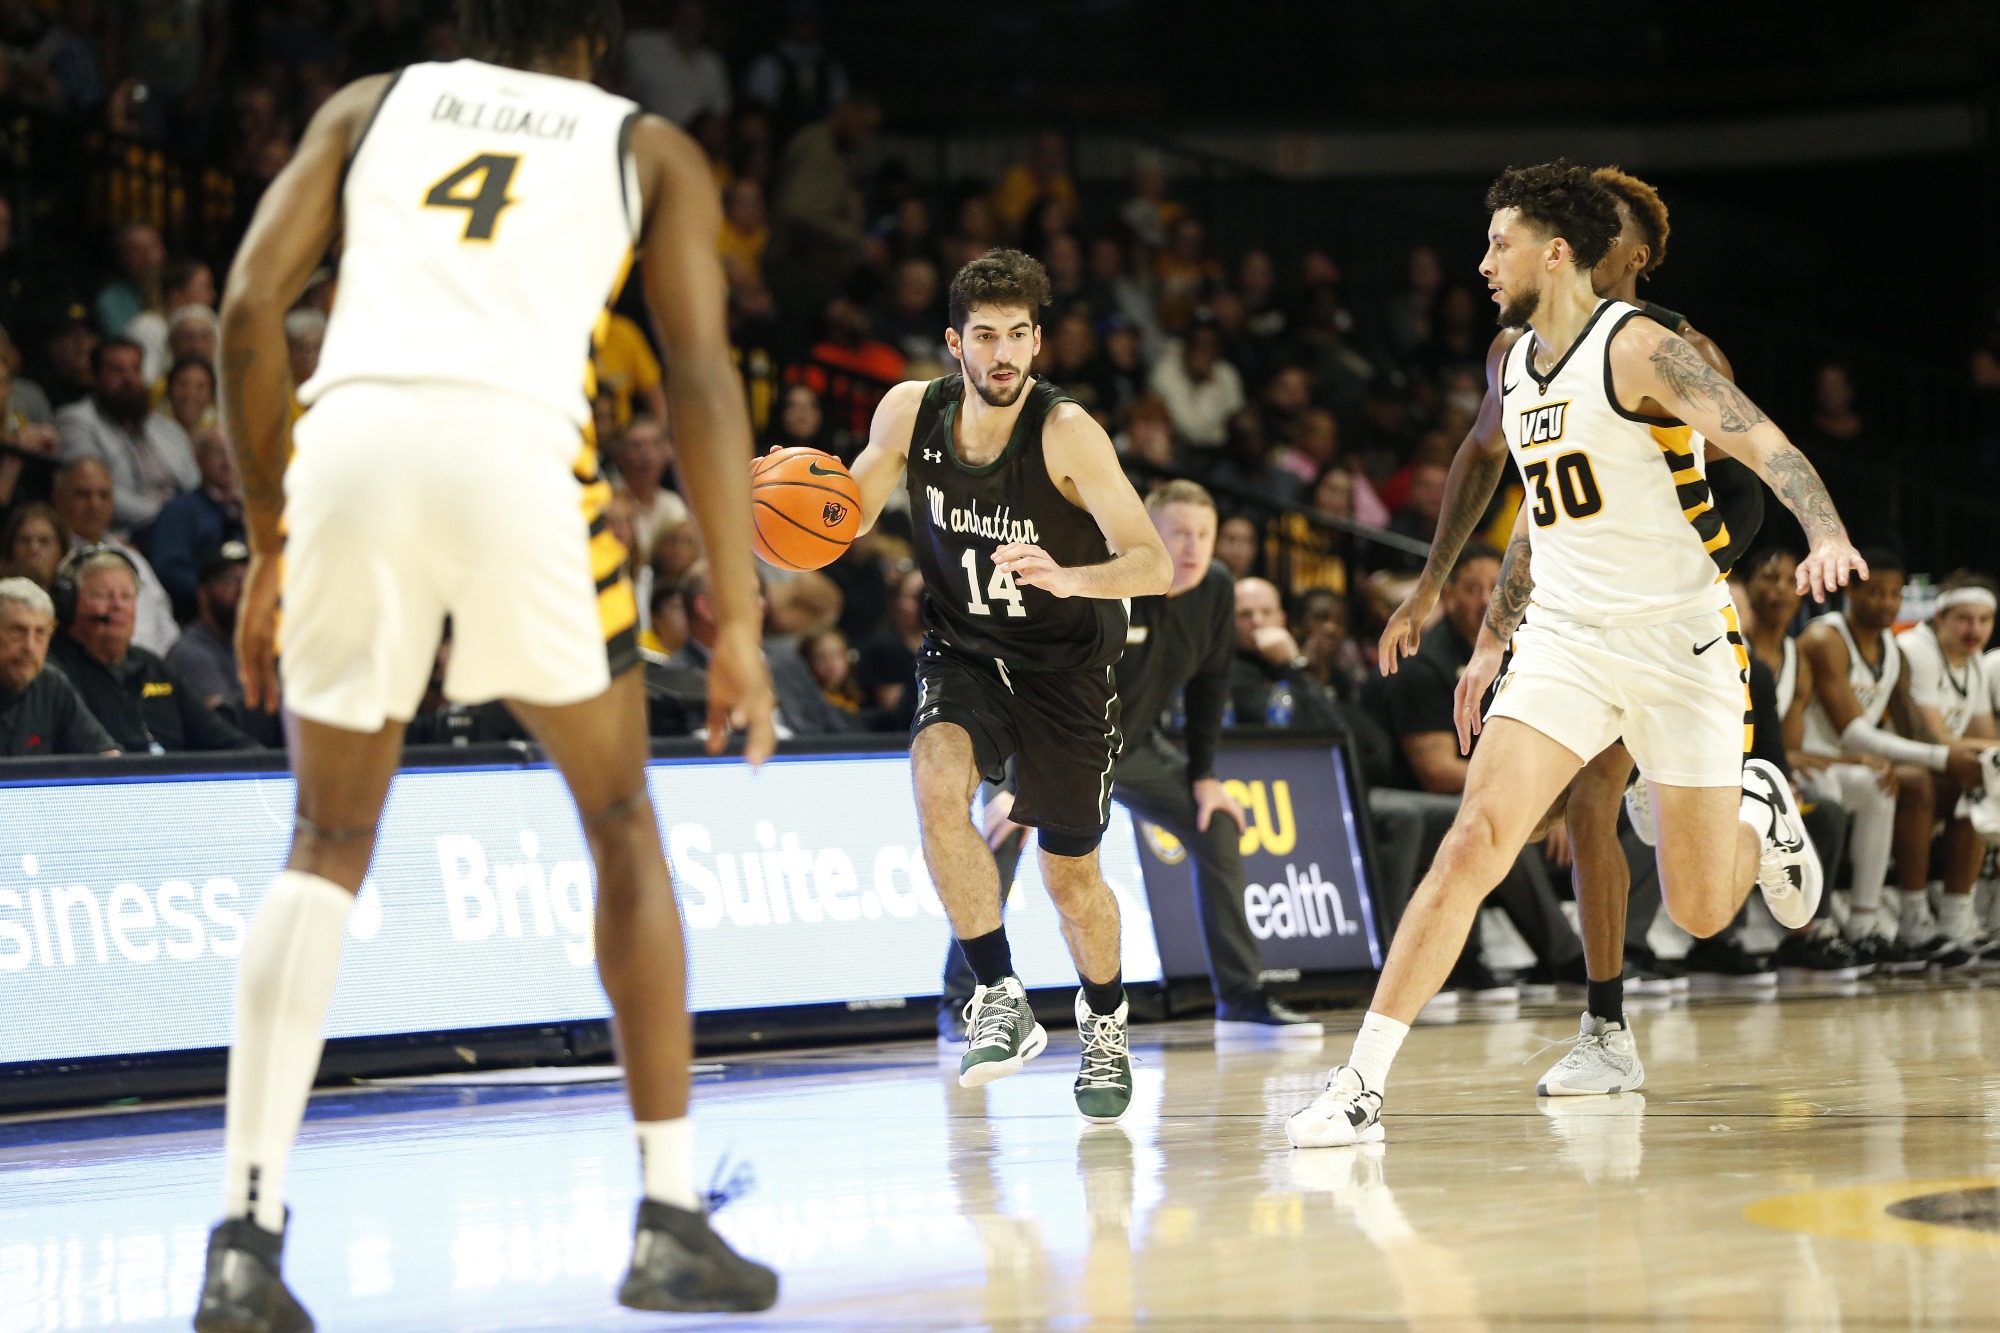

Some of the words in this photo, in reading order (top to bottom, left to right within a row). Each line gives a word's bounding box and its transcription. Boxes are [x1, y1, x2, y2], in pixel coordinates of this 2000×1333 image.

[431, 92, 579, 141] DELOACH
[423, 151, 524, 242] 4
[1520, 401, 1571, 450] VCU
[926, 485, 1040, 545] Manhattan
[1523, 449, 1604, 529] 30
[961, 548, 1027, 617] 14
[1244, 862, 1346, 940] ealth
